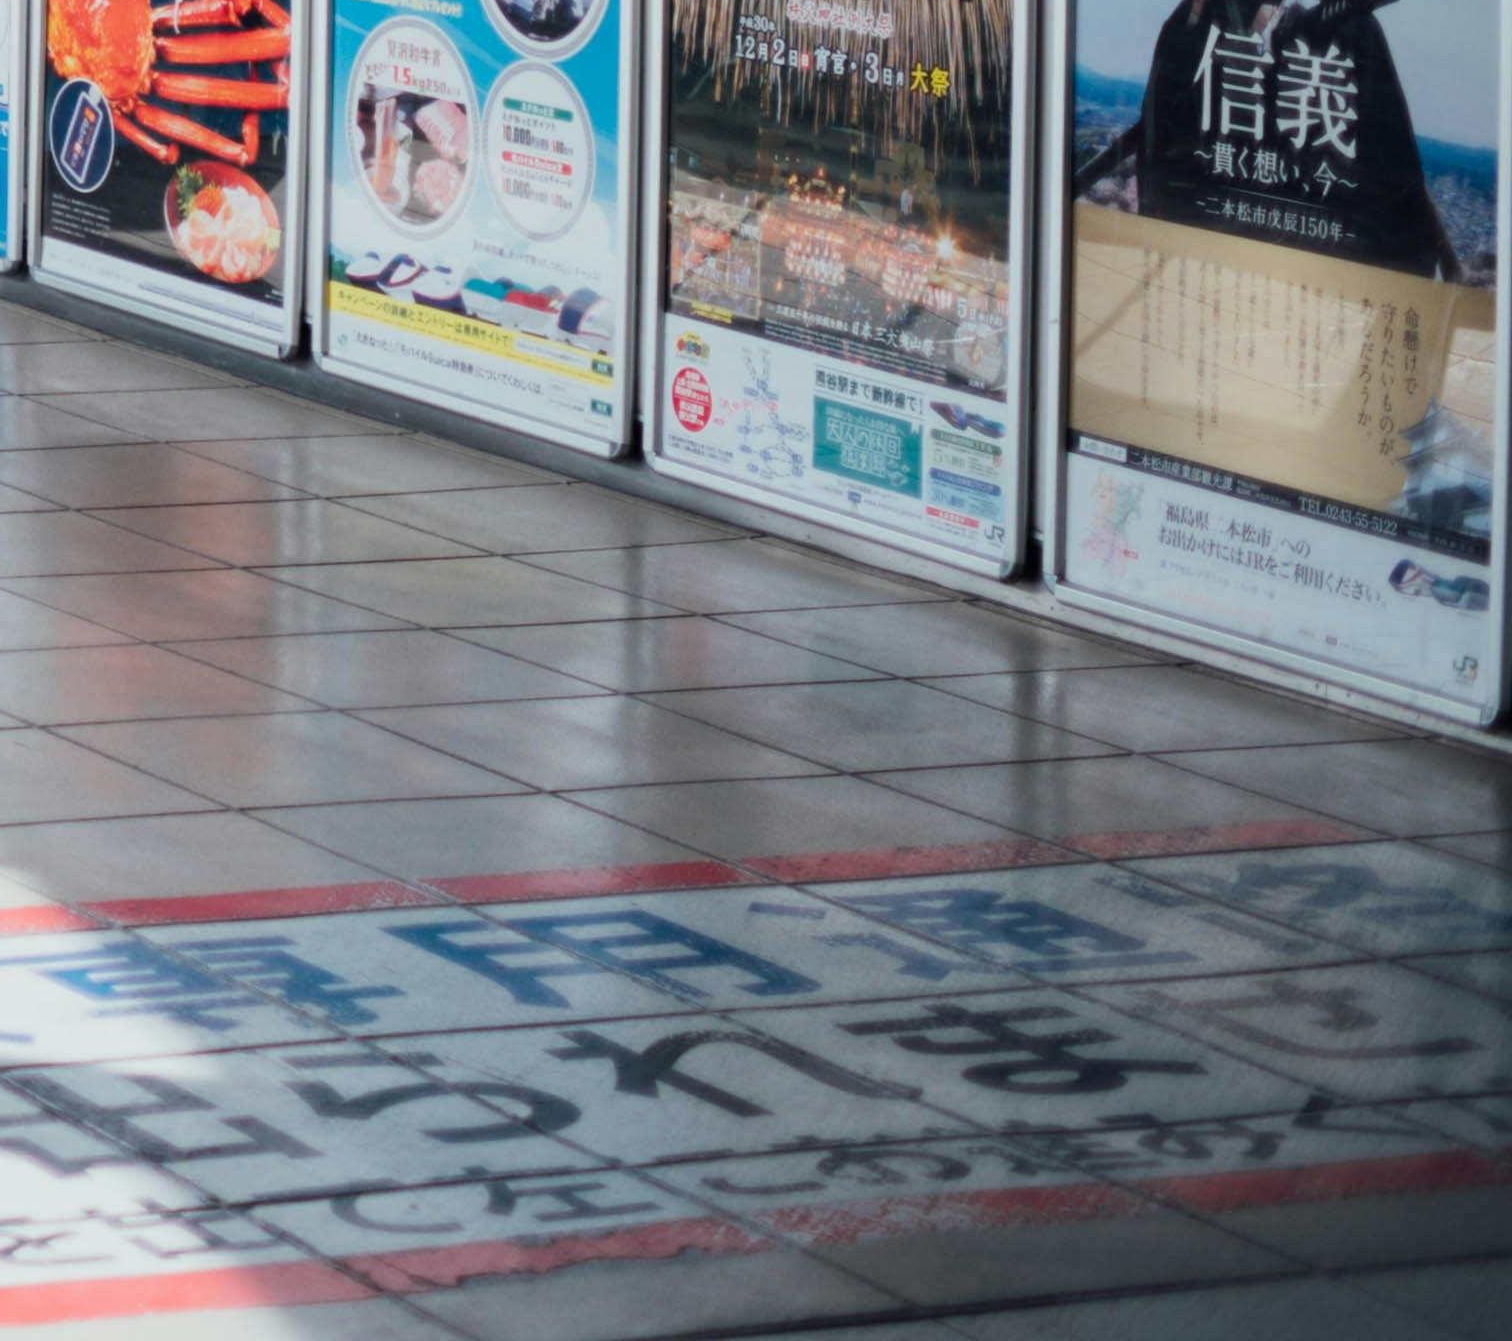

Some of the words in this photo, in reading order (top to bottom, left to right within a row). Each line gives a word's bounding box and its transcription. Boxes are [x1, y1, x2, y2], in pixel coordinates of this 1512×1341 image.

[1193, 23, 1359, 160] 信義
[1403, 306, 1422, 396] 命懸けで
[984, 523, 1006, 544] JR
